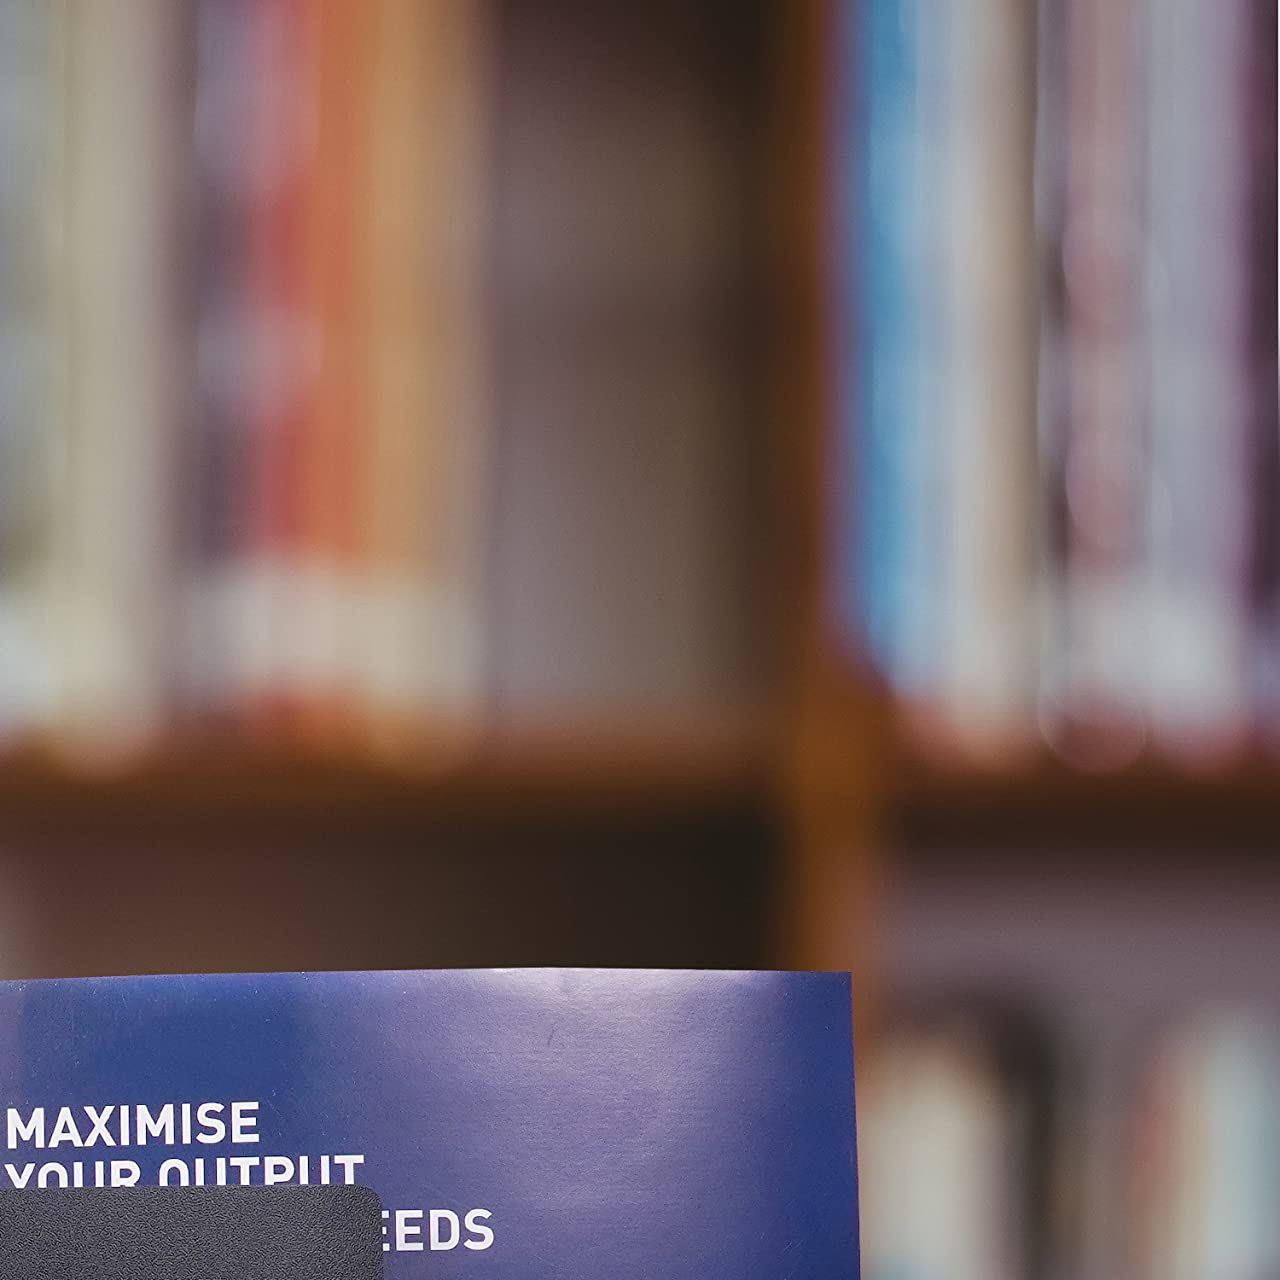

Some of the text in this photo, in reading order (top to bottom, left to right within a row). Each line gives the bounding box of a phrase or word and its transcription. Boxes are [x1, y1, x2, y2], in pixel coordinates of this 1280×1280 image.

[6, 1101, 260, 1149] MAXIMISE
[4, 1155, 364, 1188] YOUR OUTPUT
[382, 1209, 494, 1251] EDS
